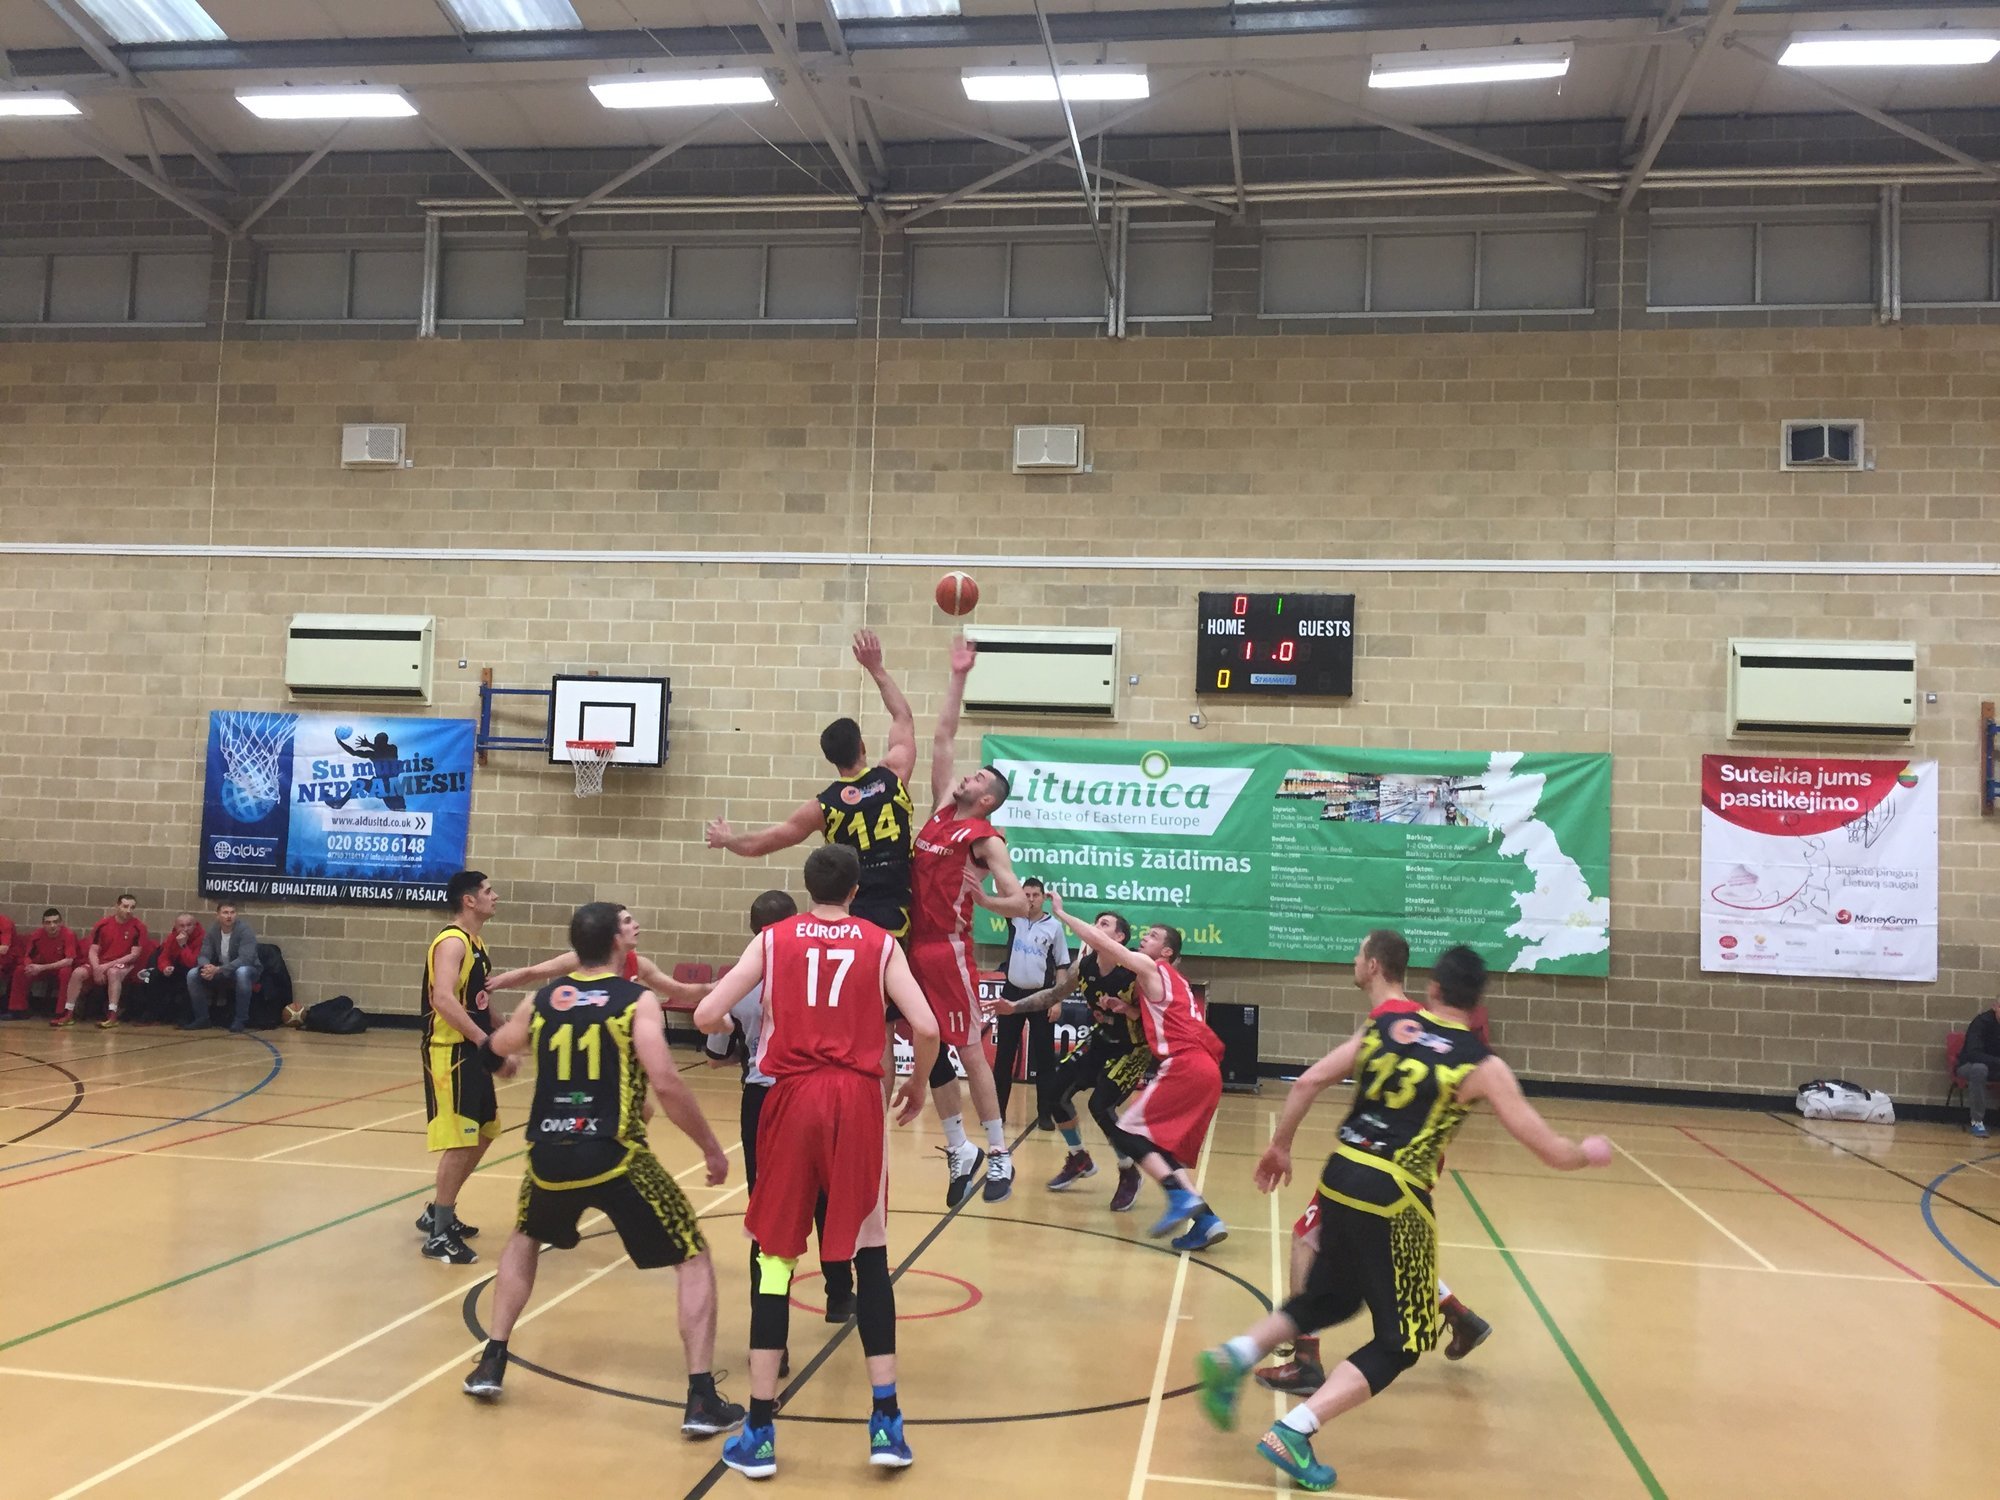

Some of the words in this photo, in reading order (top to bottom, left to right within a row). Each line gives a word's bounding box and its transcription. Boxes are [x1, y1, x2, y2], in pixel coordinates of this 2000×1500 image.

[1235, 596, 1247, 615] 0
[1277, 598, 1283, 615] 1
[1208, 619, 1246, 635] HOME
[1299, 620, 1351, 637] GUESTS
[1217, 669, 1230, 688] 0
[312, 760, 345, 780] Su
[353, 752, 434, 777] mumis
[1720, 764, 1811, 785] Suteikia
[1816, 767, 1871, 789] jums
[298, 772, 465, 803] NEPRAMESI!
[1007, 769, 1210, 809] Lituanica
[1720, 789, 1859, 813] pasitikėjimo
[332, 816, 411, 827] www.aldusltd.co.uk
[847, 803, 900, 851] 14
[1008, 807, 1031, 820] The
[1036, 809, 1070, 821] Taste
[1075, 810, 1090, 823] of
[1093, 812, 1146, 825] Eastern
[1151, 813, 1200, 829] Europe
[232, 844, 265, 858] aldus
[328, 835, 351, 850] 020
[354, 836, 388, 852] 8558
[391, 837, 425, 853] 6148
[1006, 845, 1134, 869] omandinis
[1141, 850, 1251, 873] žaidimas
[206, 879, 258, 893] MOKESČIAI
[271, 883, 337, 897] BUHALTERIJA
[350, 886, 393, 899] VERSLAS
[1105, 881, 1190, 907] sėkmę!
[796, 922, 863, 940] EUROPA
[1854, 914, 1918, 928] MoneyGram
[805, 948, 855, 1007] 17
[949, 1011, 964, 1033] 11
[549, 1024, 601, 1081] 11
[1365, 1052, 1429, 1109] 13
